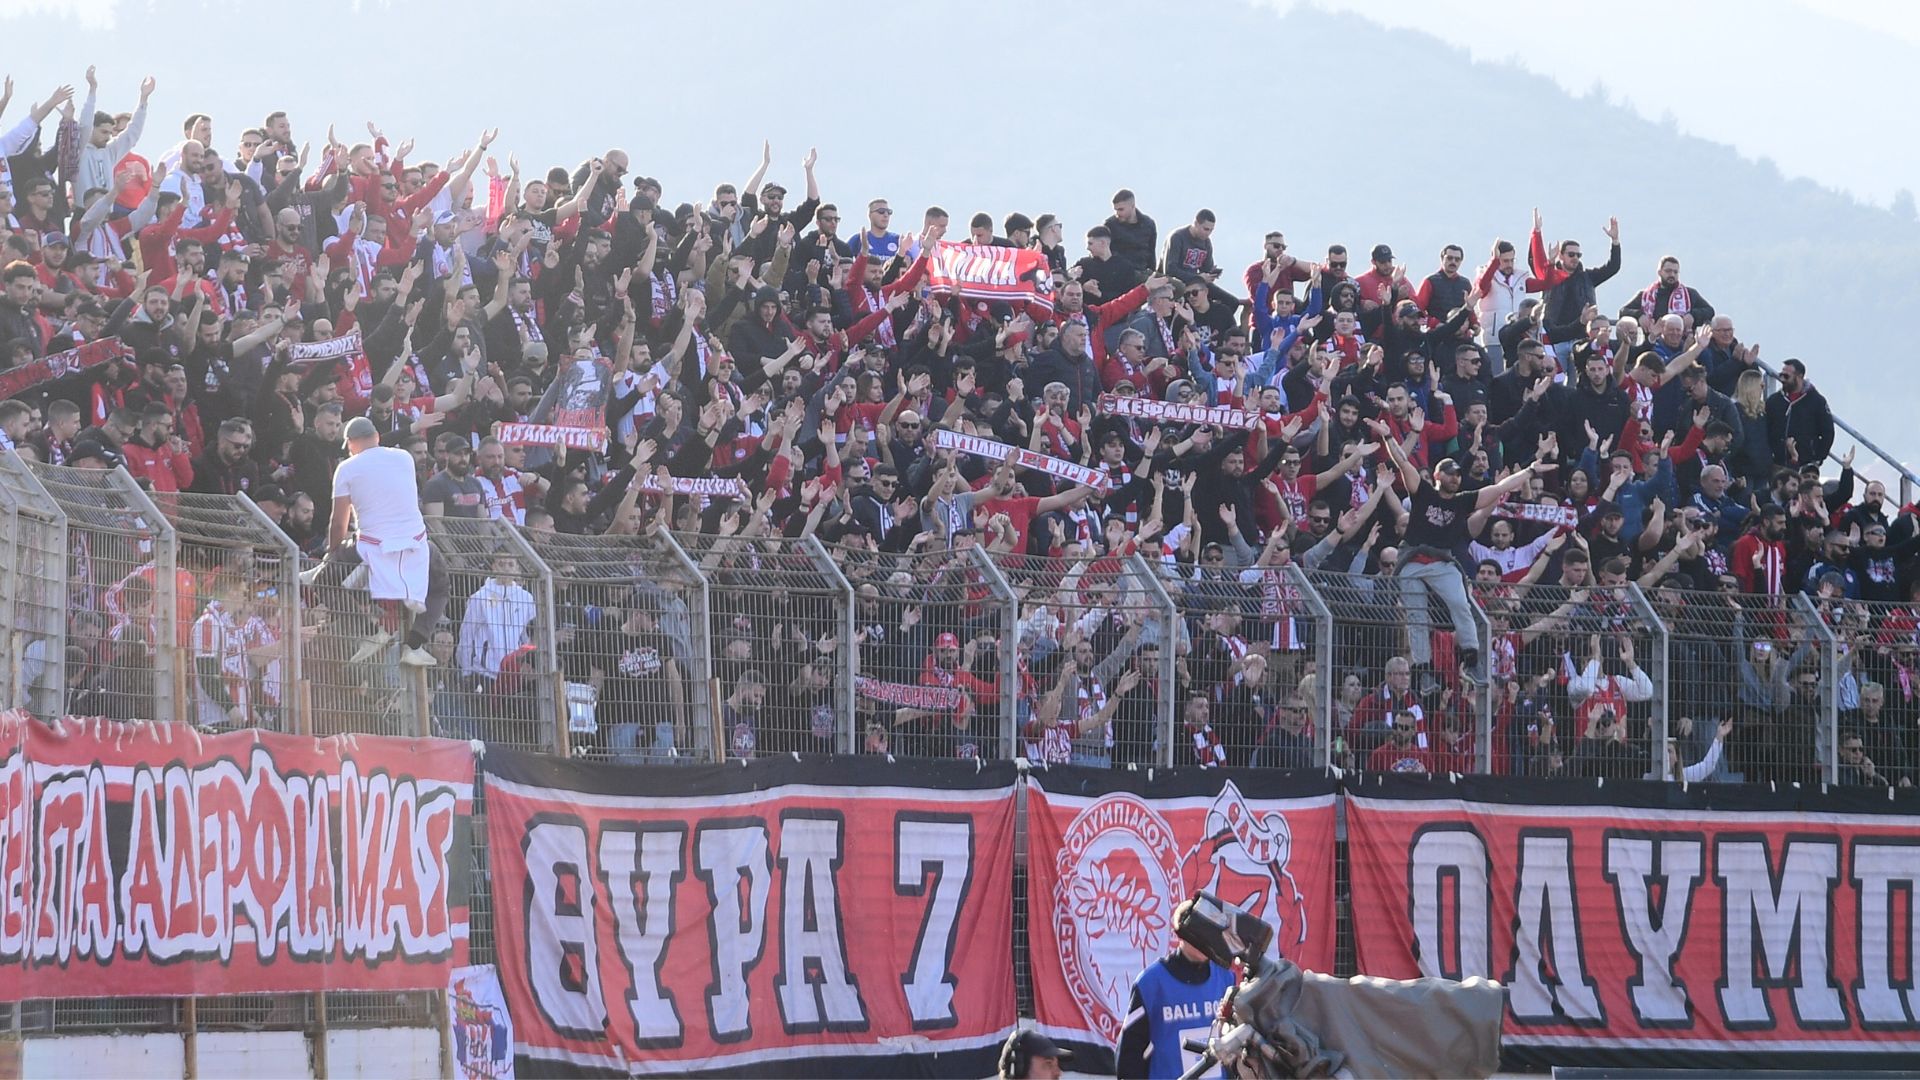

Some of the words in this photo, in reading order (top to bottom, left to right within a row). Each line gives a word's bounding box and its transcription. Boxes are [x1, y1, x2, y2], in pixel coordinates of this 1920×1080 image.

[1116, 398, 1244, 427] ΚΕΦΑΛΟΝΙΑ
[938, 431, 1024, 464] ΜΥΤΙΛΗΝ
[1070, 802, 1170, 859] ΟΛΥΜΠΙΑΚΟΣ
[123, 747, 336, 963] ΑΔΕΡΦΙΑ
[341, 757, 456, 963] ΜΑΣ
[522, 809, 869, 1046] ΘΥΡΑ
[895, 811, 975, 1029] 7
[1162, 1003, 1201, 1021] BALL
[1204, 1000, 1222, 1016] BO
